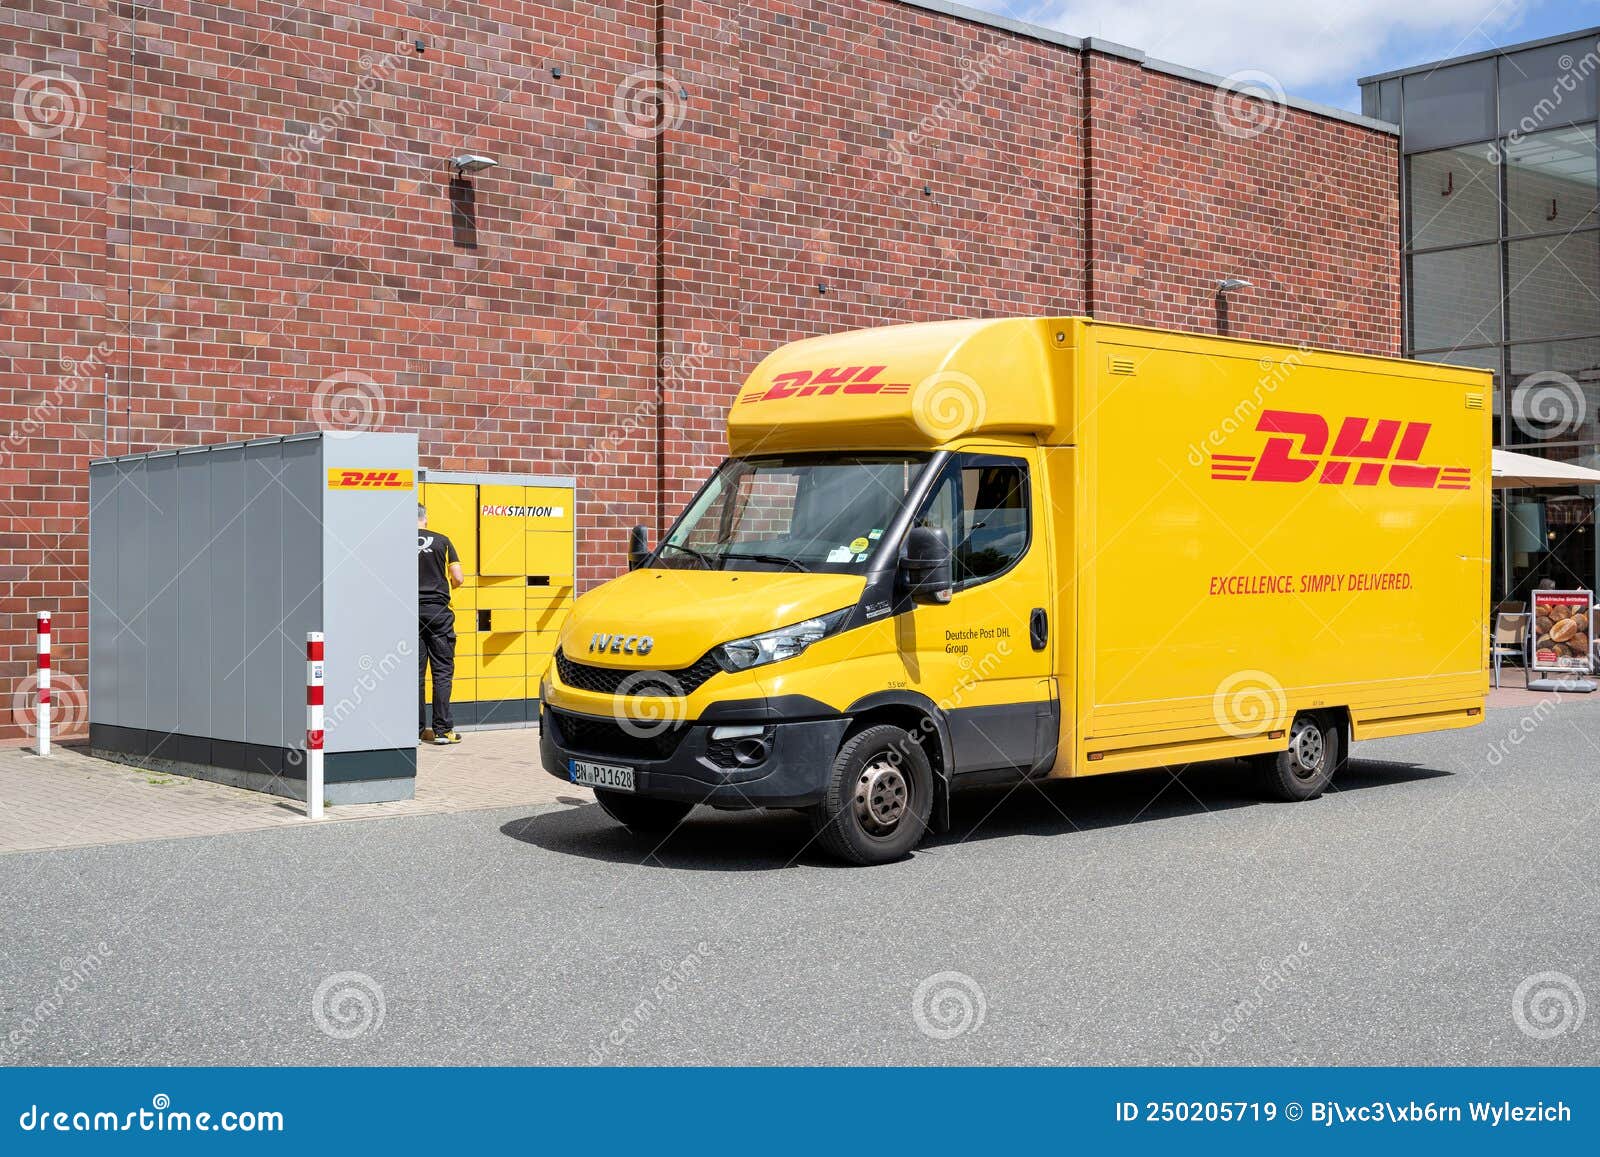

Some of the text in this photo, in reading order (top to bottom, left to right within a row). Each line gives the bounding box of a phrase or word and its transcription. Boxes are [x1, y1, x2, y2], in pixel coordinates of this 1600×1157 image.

[760, 366, 887, 401] DHL
[1251, 410, 1441, 489] DHL
[340, 472, 402, 486] DHL
[482, 505, 552, 517] PACKSTATION
[1210, 573, 1413, 595] EXCELLENCE. SIMPLY DELIVERED.
[945, 627, 1010, 640] Deutsche Post DHL
[589, 632, 654, 656] IVECO
[945, 643, 969, 655] Group
